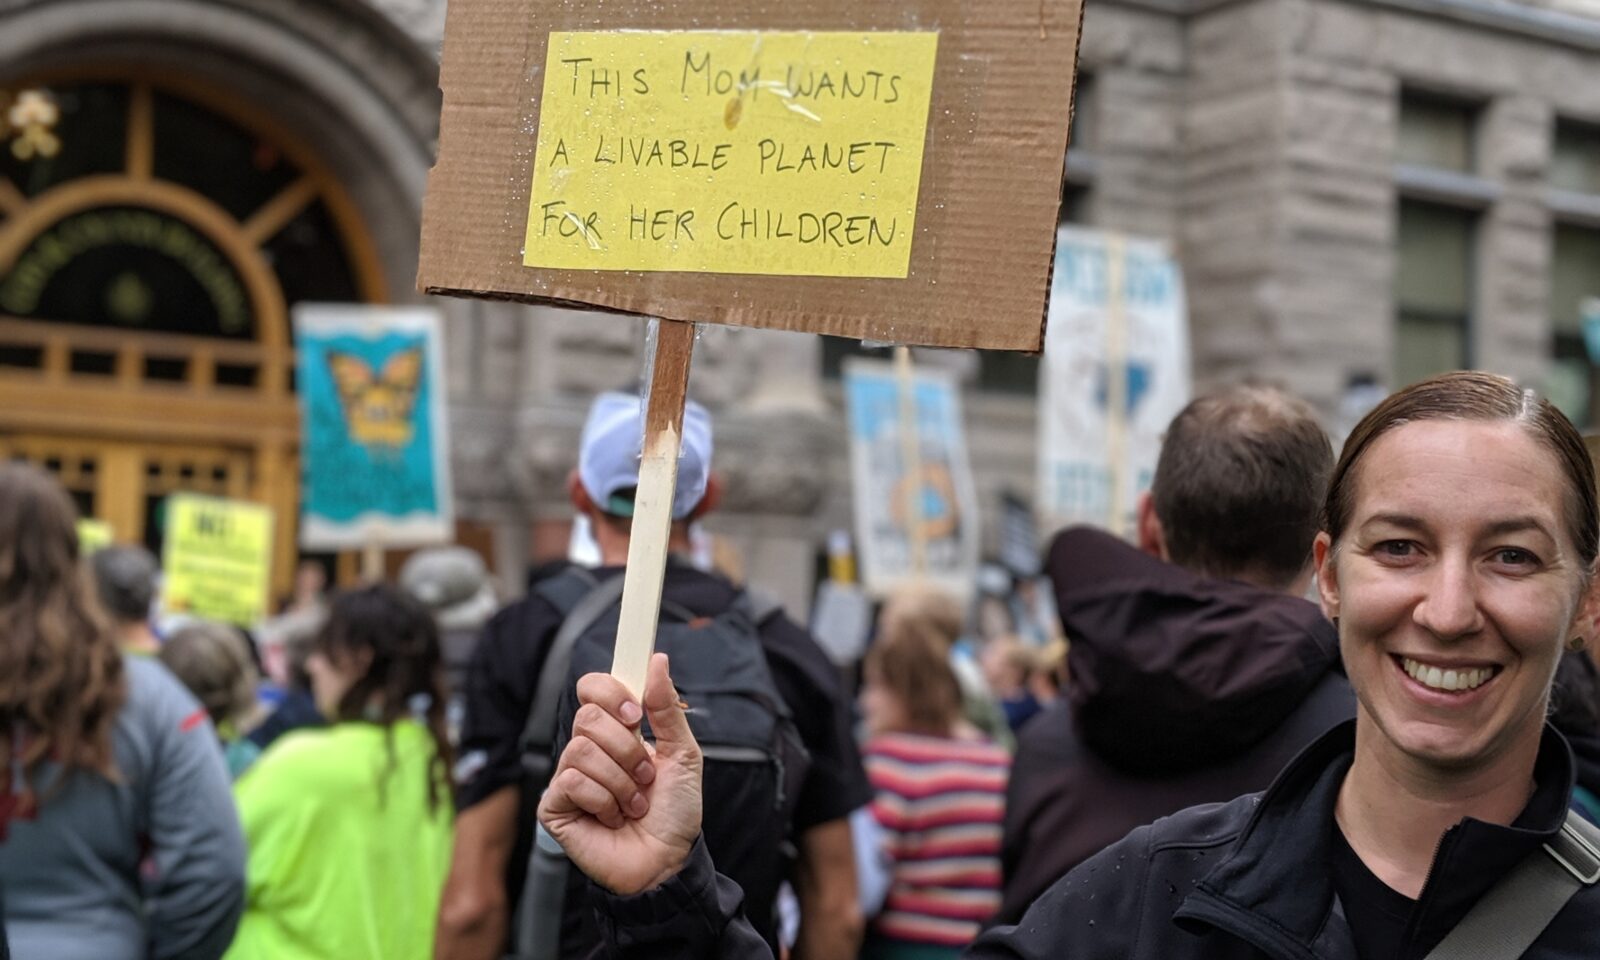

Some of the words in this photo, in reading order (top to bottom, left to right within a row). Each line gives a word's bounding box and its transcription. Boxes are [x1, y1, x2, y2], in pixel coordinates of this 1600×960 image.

[562, 57, 650, 97] THIS
[680, 50, 760, 102] MOM
[786, 65, 902, 104] WANTS
[549, 138, 569, 167] A
[594, 134, 732, 171] LIVABLE
[758, 138, 896, 174] PLANET
[541, 200, 603, 241] FOR
[629, 204, 695, 242] HER
[716, 201, 896, 248] CHILDREN
